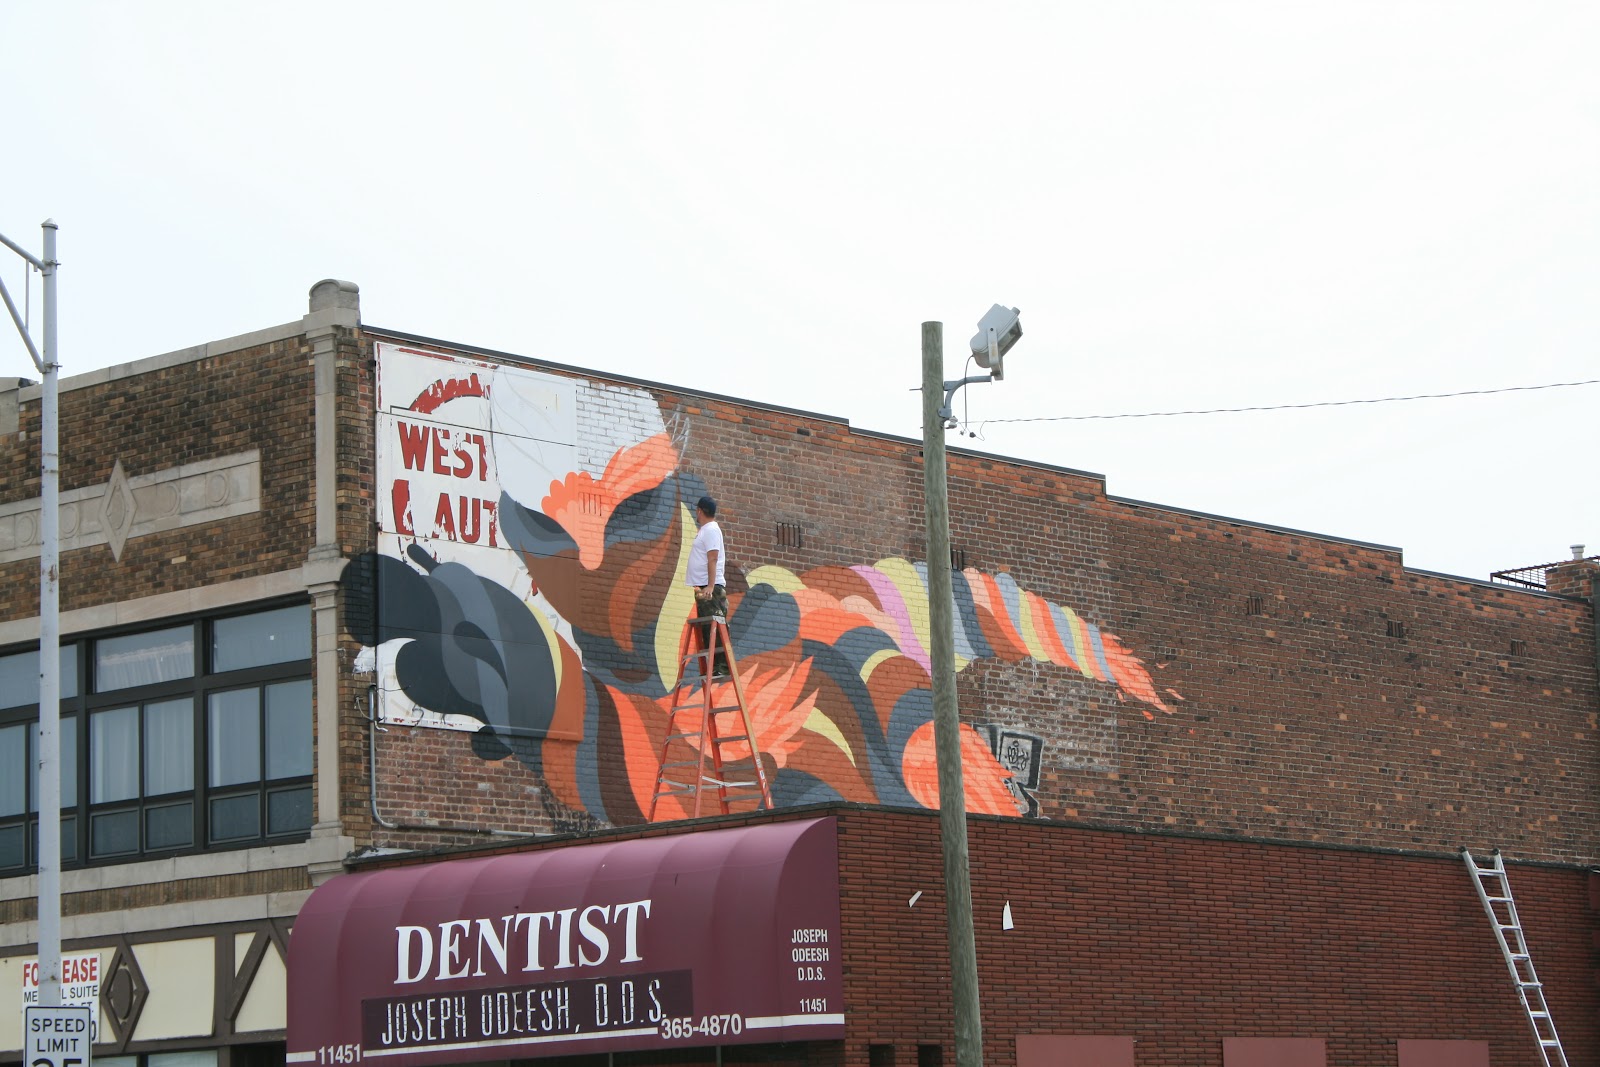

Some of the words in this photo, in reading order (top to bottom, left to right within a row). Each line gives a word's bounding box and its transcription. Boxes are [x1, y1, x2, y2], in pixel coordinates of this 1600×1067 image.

[398, 421, 488, 482] WEST
[394, 899, 652, 985] DENTIST
[792, 929, 828, 944] JOSEPH
[792, 948, 830, 963] ODEESH
[23, 962, 39, 988] FO
[62, 957, 98, 984] EASE
[797, 967, 826, 981] D.D.S.
[69, 985, 98, 999] SUITE
[799, 998, 827, 1013] 11451
[31, 1018, 86, 1033] SPEED
[381, 996, 467, 1045] JOSEPH
[661, 1013, 742, 1040] 365-4870
[36, 1038, 79, 1053] LIMIT
[318, 1043, 361, 1065] 11451
